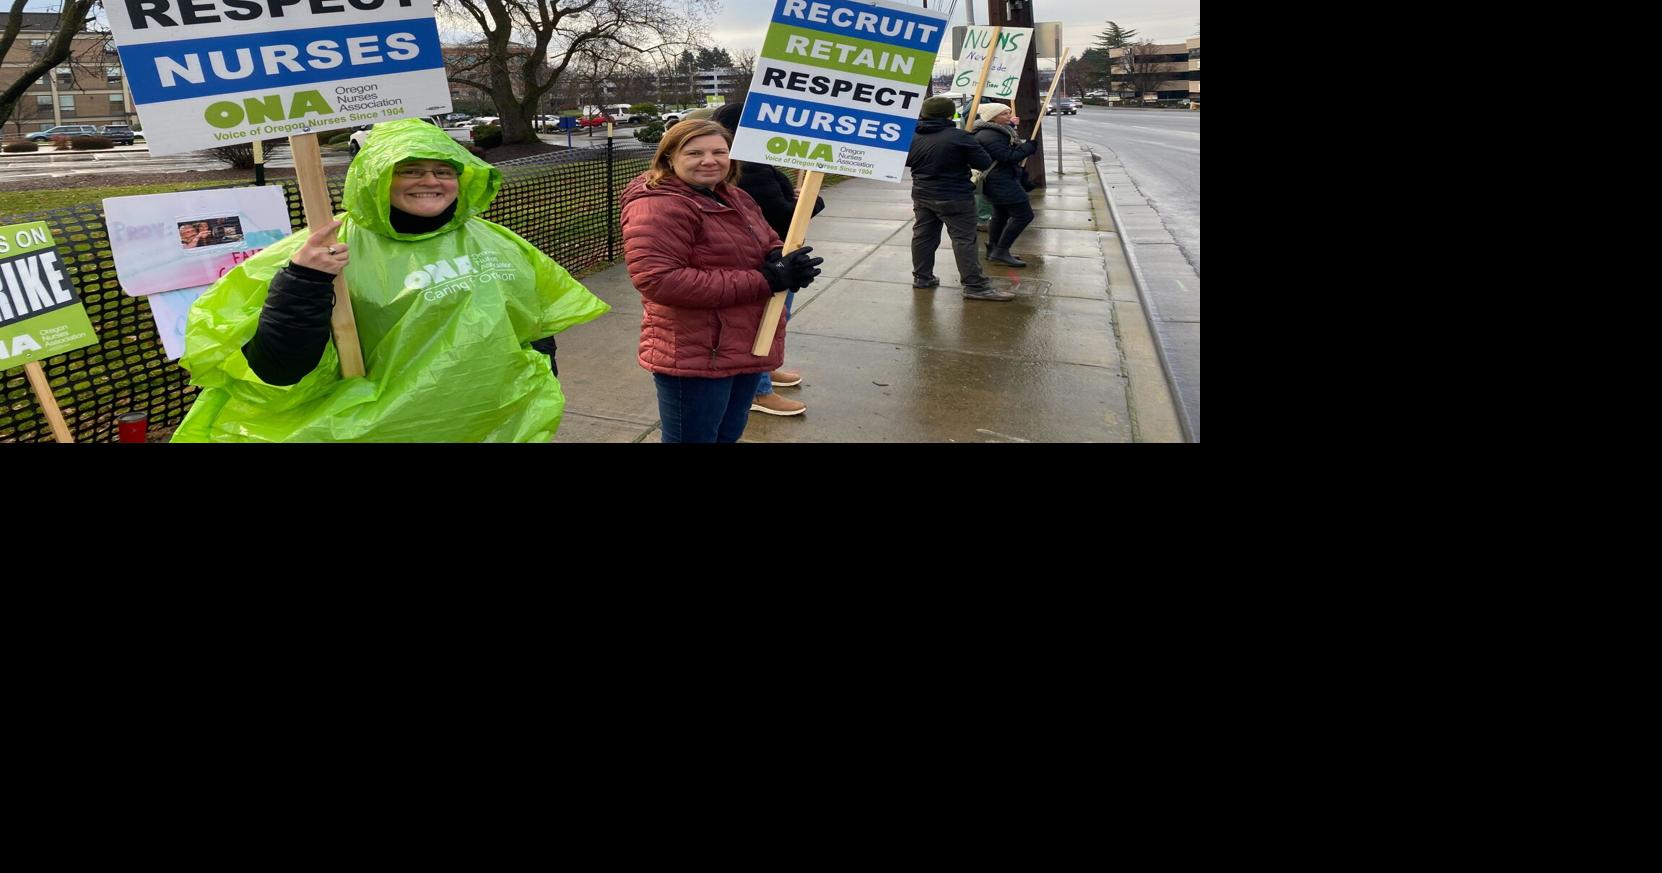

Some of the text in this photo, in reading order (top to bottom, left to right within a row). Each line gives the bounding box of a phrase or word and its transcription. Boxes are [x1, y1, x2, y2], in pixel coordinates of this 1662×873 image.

[126, 0, 413, 30] RESPE
[782, 0, 938, 43] RECRUIT
[154, 32, 420, 88] NURSES
[785, 34, 915, 75] RETAIN
[966, 51, 999, 61] Nevr
[335, 84, 378, 96] Oregon
[762, 67, 919, 109] RESPECT
[955, 70, 974, 88] 6
[996, 75, 1019, 97] $
[337, 92, 378, 104] Nurses
[339, 97, 402, 113] Association
[204, 90, 334, 129] ONA
[214, 106, 405, 142] Voice of Oregon Nurses Since 1904
[757, 102, 902, 142] NURSES
[766, 136, 834, 162] ONA
[838, 153, 862, 161] Nurses
[840, 146, 866, 156] Oregon
[765, 154, 782, 162] Voice
[816, 162, 838, 171] Nrses
[836, 159, 875, 168] Association
[16, 226, 48, 248] ON
[232, 248, 264, 264] FA
[423, 280, 471, 302] Caring
